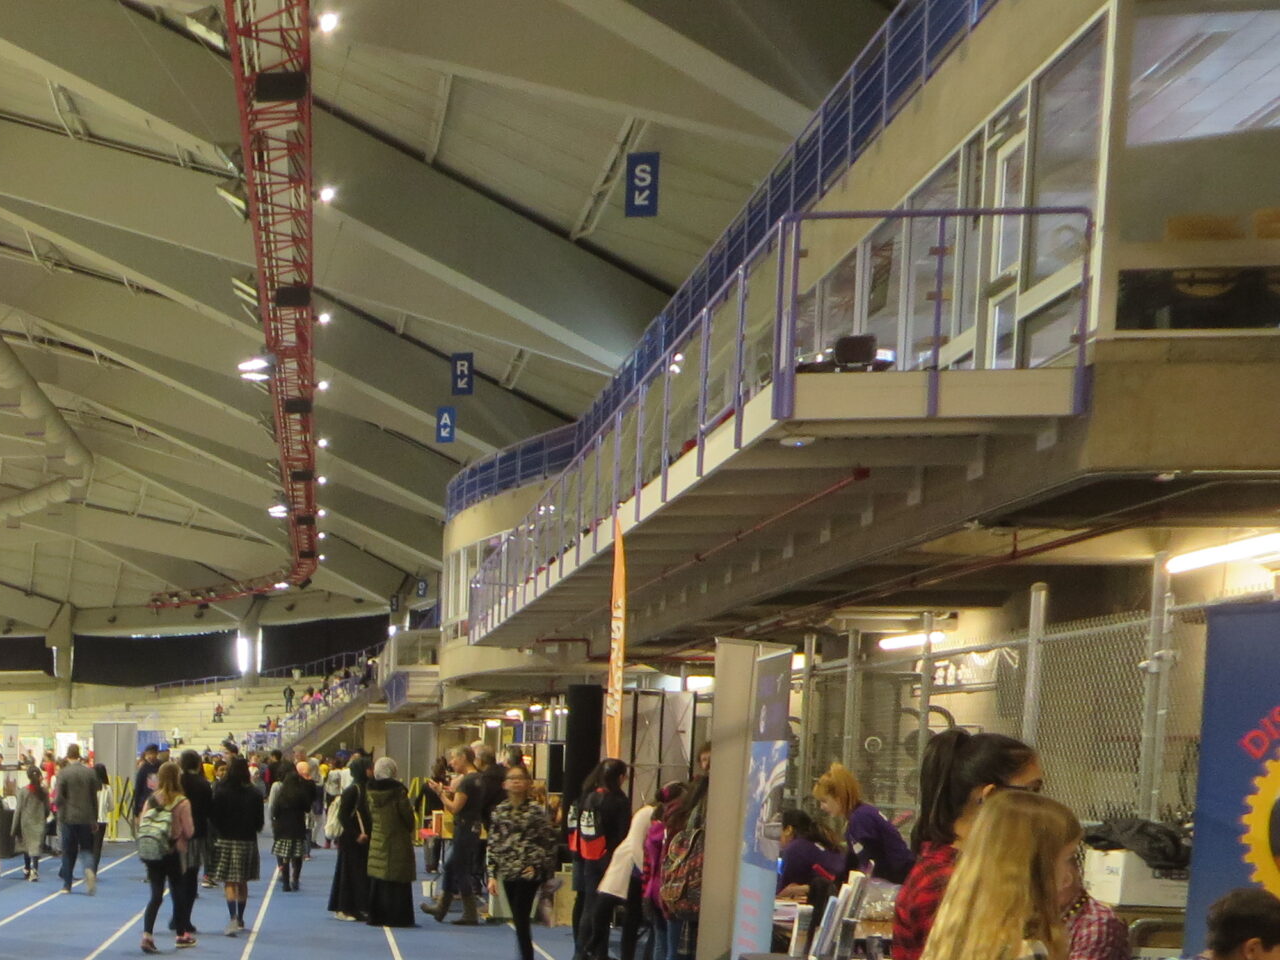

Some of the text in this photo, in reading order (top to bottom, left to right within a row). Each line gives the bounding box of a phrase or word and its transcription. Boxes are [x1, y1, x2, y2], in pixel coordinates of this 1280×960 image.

[633, 164, 652, 187] S
[455, 360, 471, 376] R
[439, 413, 452, 426] A
